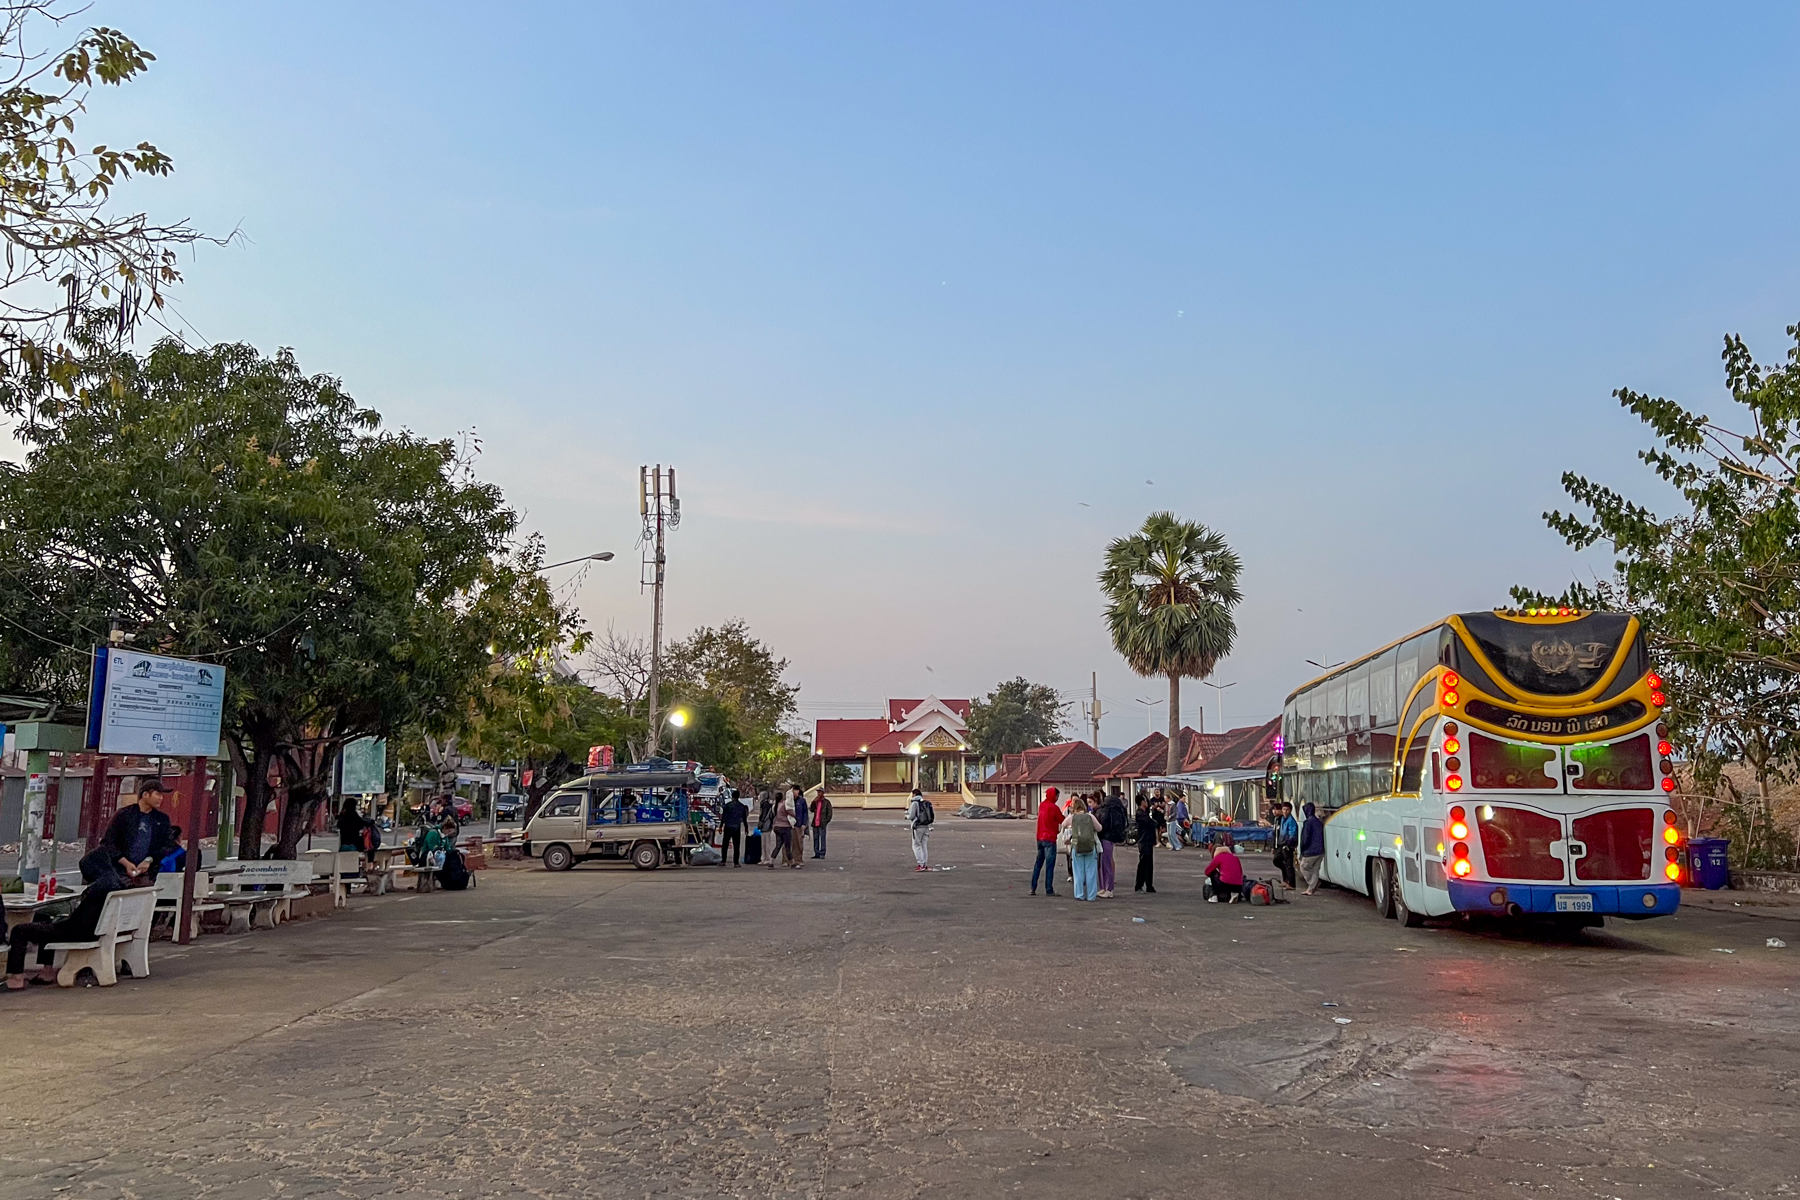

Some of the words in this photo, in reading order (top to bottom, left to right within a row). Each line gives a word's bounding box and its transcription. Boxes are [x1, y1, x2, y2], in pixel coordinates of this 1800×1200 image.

[1539, 645, 1566, 656] CPS
[240, 864, 287, 873] Sacombank
[1571, 901, 1592, 911] 1999
